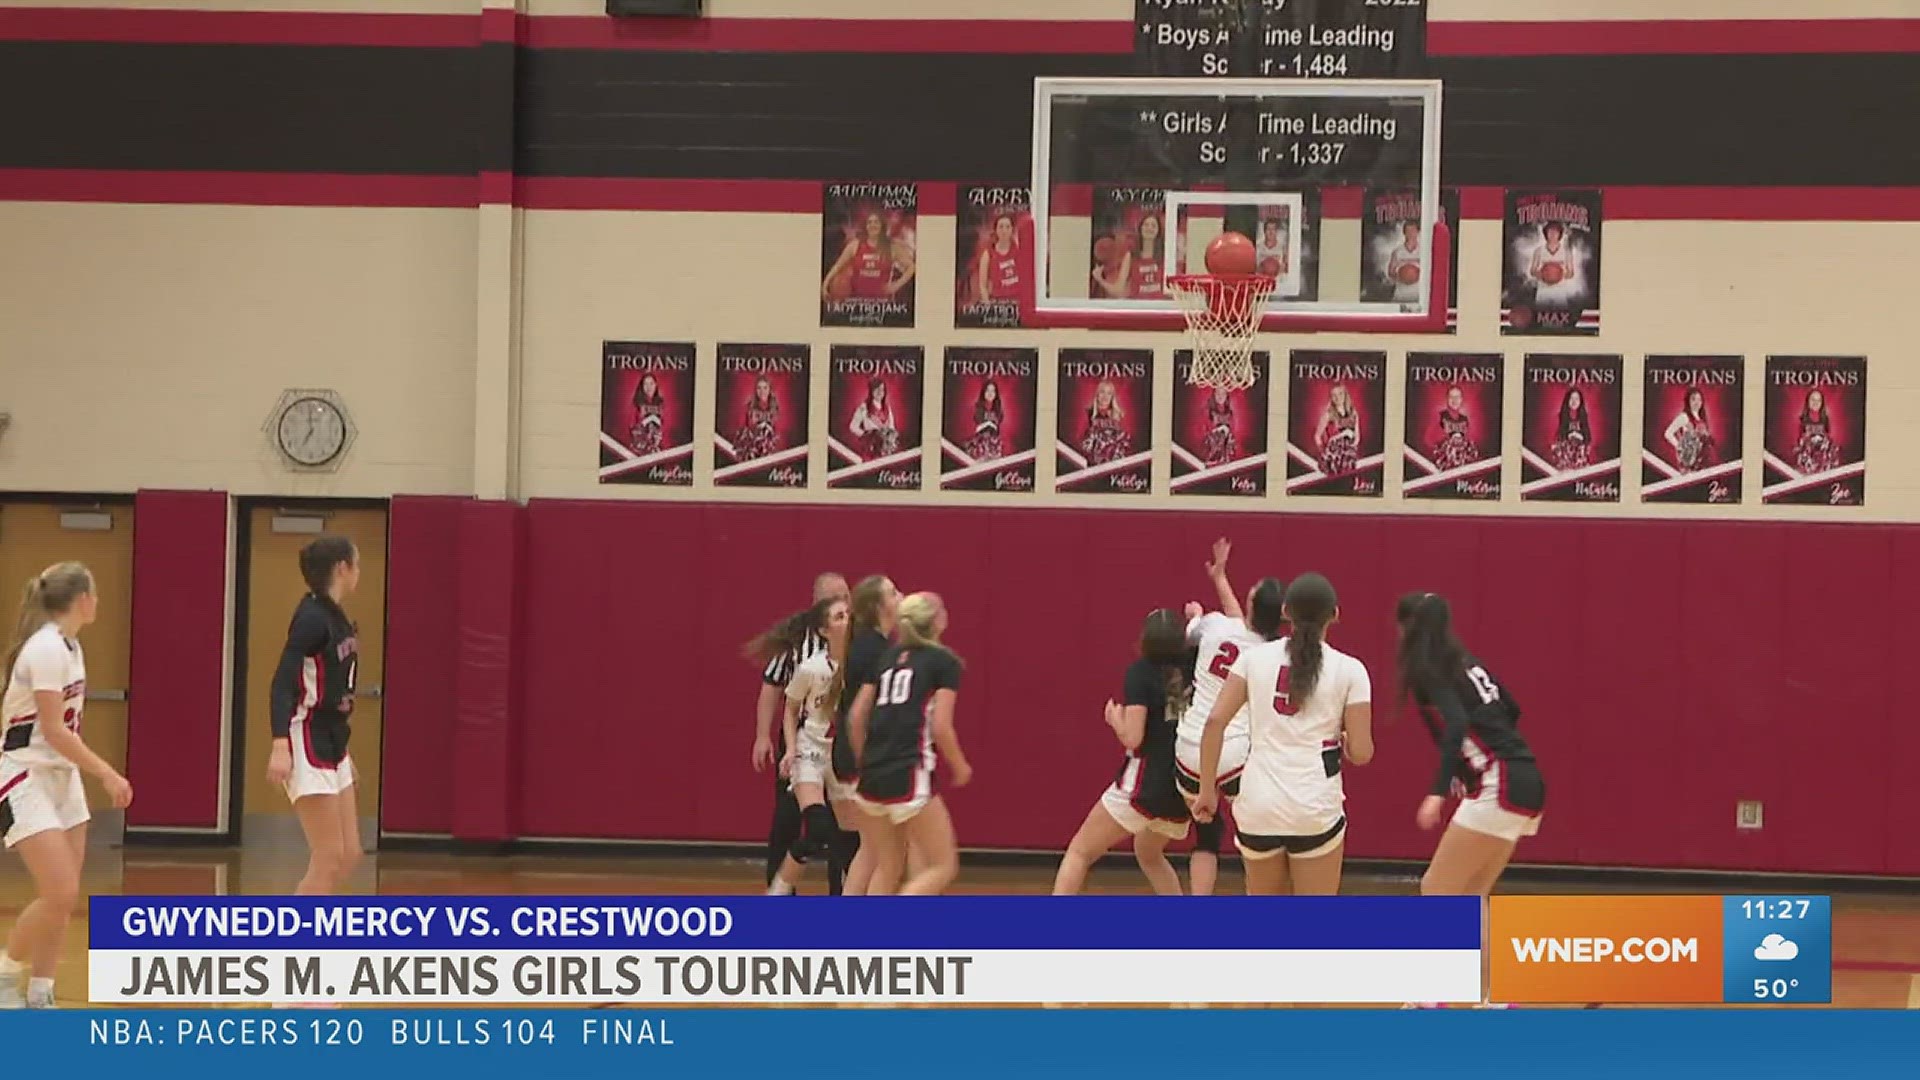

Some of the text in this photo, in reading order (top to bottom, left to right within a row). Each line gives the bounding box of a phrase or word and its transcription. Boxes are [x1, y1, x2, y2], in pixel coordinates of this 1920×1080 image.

[1158, 24, 1211, 50] Boys
[1309, 24, 1395, 51] Leading
[1294, 54, 1348, 78] 1,484
[1163, 112, 1212, 134] Girls
[1311, 113, 1397, 140] Leading
[1290, 143, 1345, 166] 1,337
[608, 355, 689, 371] TROJANS
[722, 356, 803, 372] TROJANS
[836, 359, 917, 376] TROJANS
[950, 360, 1031, 378] TROJANS
[1063, 362, 1146, 379] TROJANS
[1295, 363, 1379, 381] TROJANS
[1411, 366, 1496, 384] TROJANS
[1529, 368, 1616, 386] TROJANS
[1650, 369, 1736, 387] TROJANS
[1770, 370, 1859, 389] TROJANS
[1208, 642, 1240, 680] 2
[876, 668, 915, 706] 10
